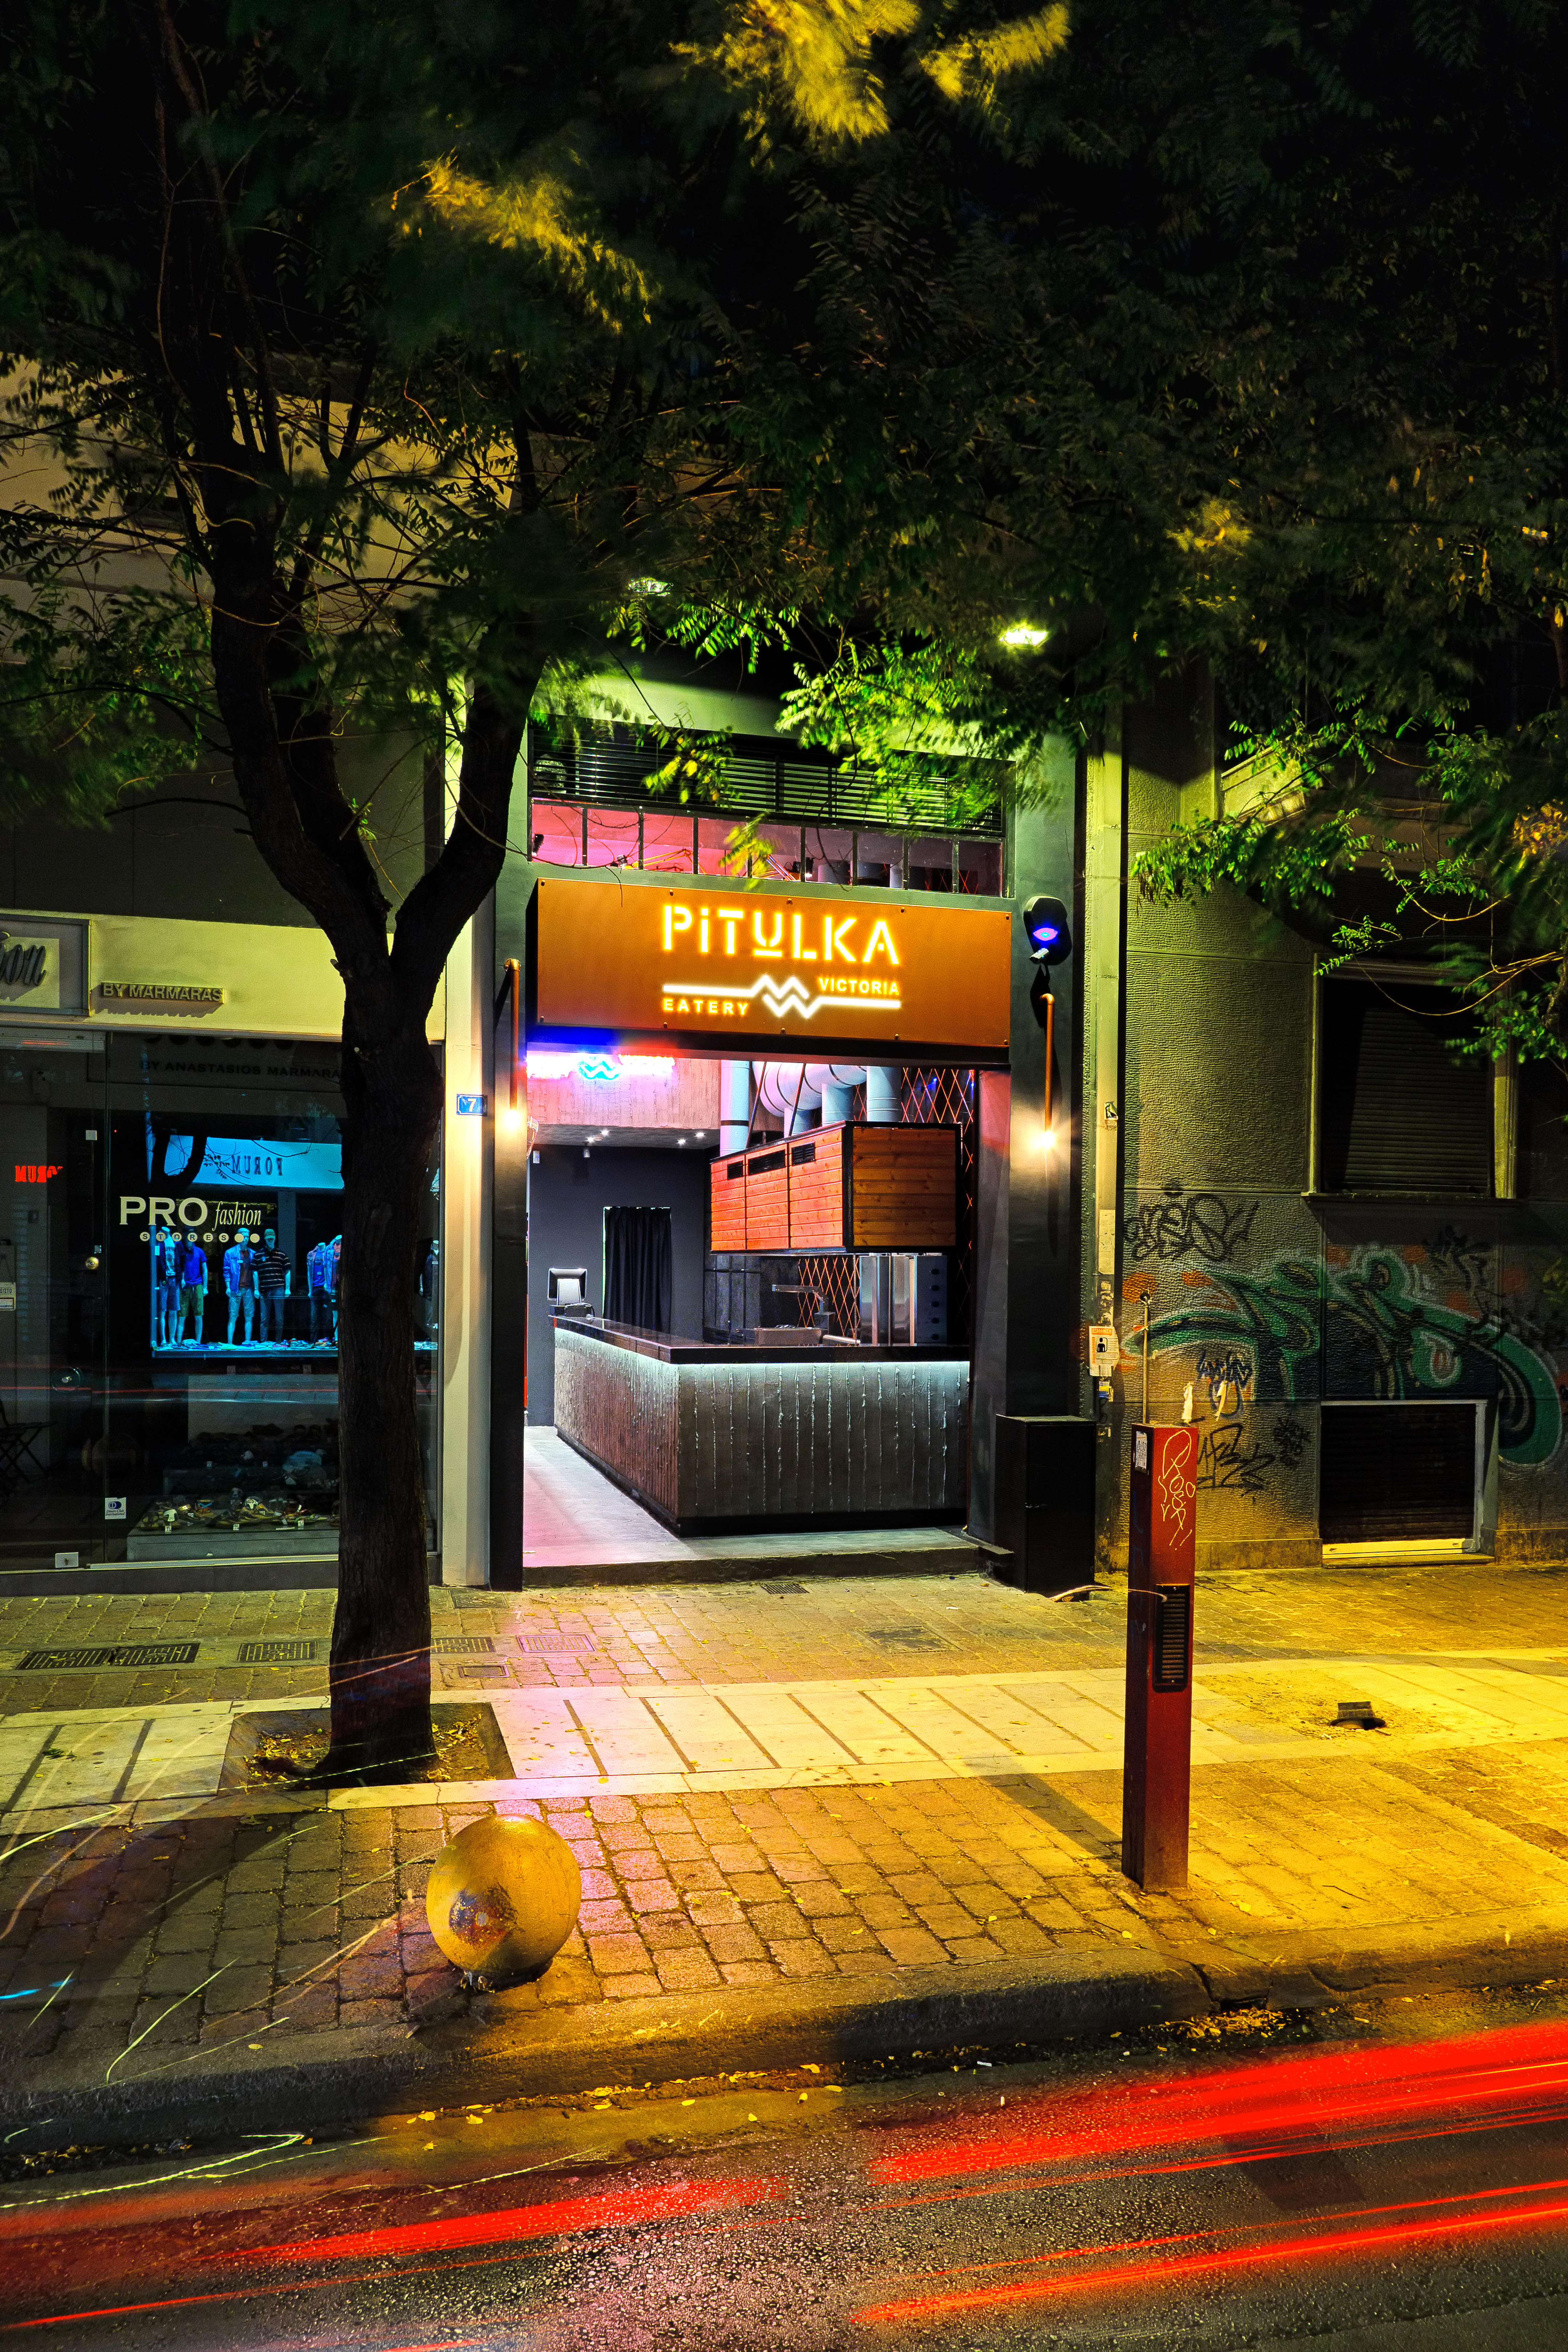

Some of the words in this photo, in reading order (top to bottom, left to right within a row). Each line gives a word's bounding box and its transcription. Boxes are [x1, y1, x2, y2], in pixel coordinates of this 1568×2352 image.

[103, 983, 124, 997] BY
[129, 984, 222, 1001] MARMARAS
[818, 977, 900, 996] VICTORIA
[663, 998, 749, 1015] EATERY
[141, 1061, 160, 1070] BY
[165, 1062, 261, 1075] ANASTASIOS
[467, 1098, 477, 1112] 7
[119, 1196, 208, 1226] PRO
[212, 1201, 262, 1232] fashion
[140, 1232, 229, 1243] STORES
